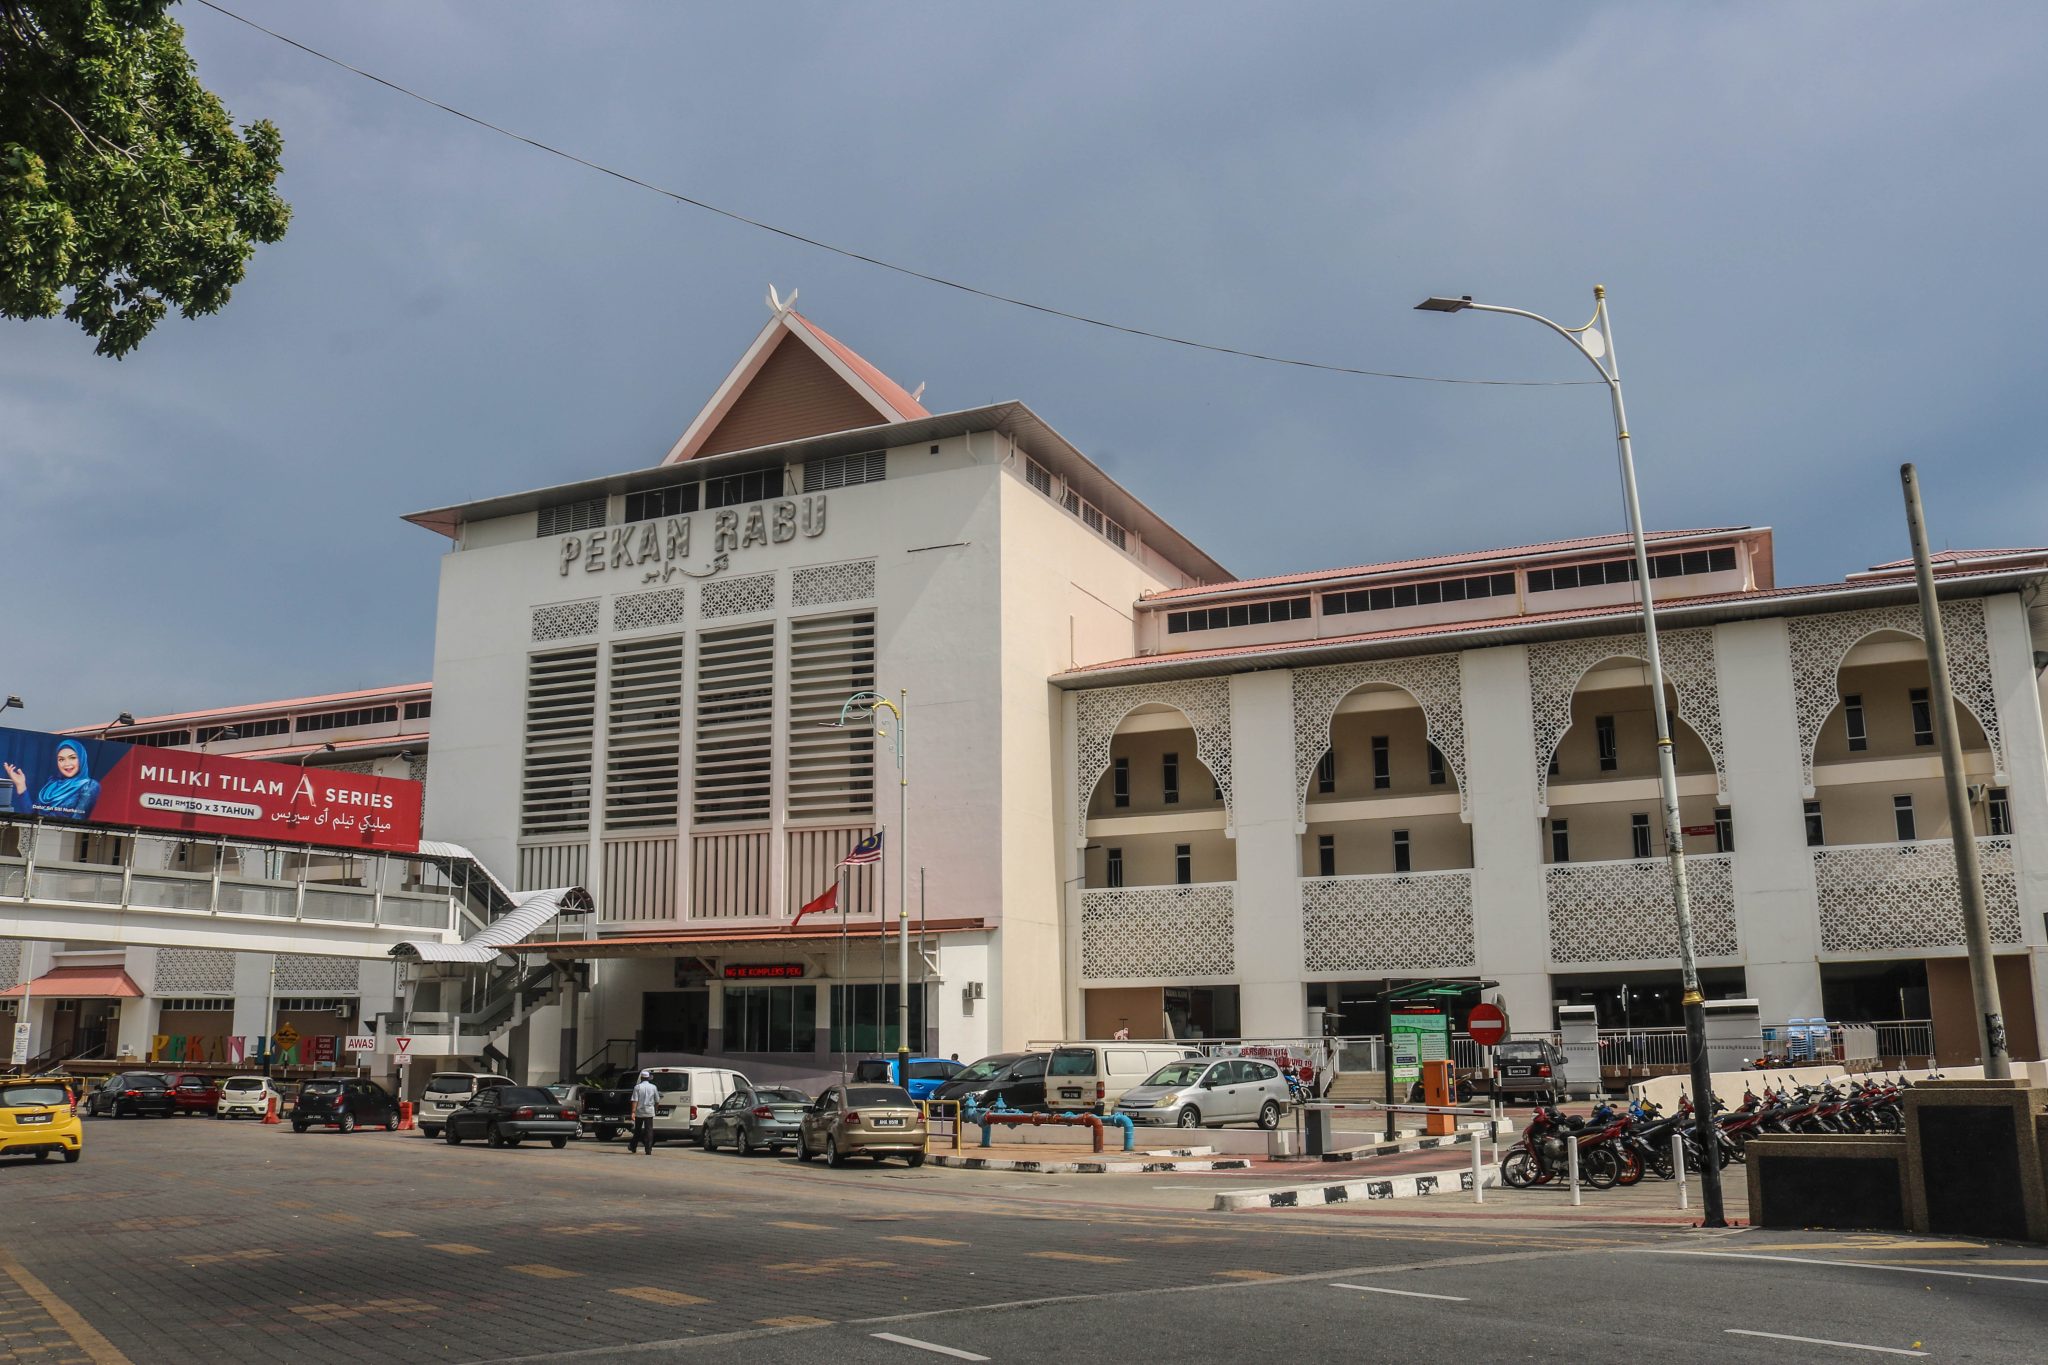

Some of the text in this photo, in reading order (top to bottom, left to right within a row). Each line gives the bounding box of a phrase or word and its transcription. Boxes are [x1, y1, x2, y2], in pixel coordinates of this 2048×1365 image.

[559, 494, 827, 577] PEKAN RABU
[140, 765, 393, 809] MILIKI TILAM A SERIES
[148, 797, 173, 807] DARI
[212, 804, 219, 812] 3
[221, 805, 255, 816] TAHUN
[749, 967, 785, 976] KOMPLEKS
[152, 1035, 247, 1065] PEKAN
[348, 1038, 374, 1049] AWAS
[1241, 1047, 1272, 1057] BERSAMA
